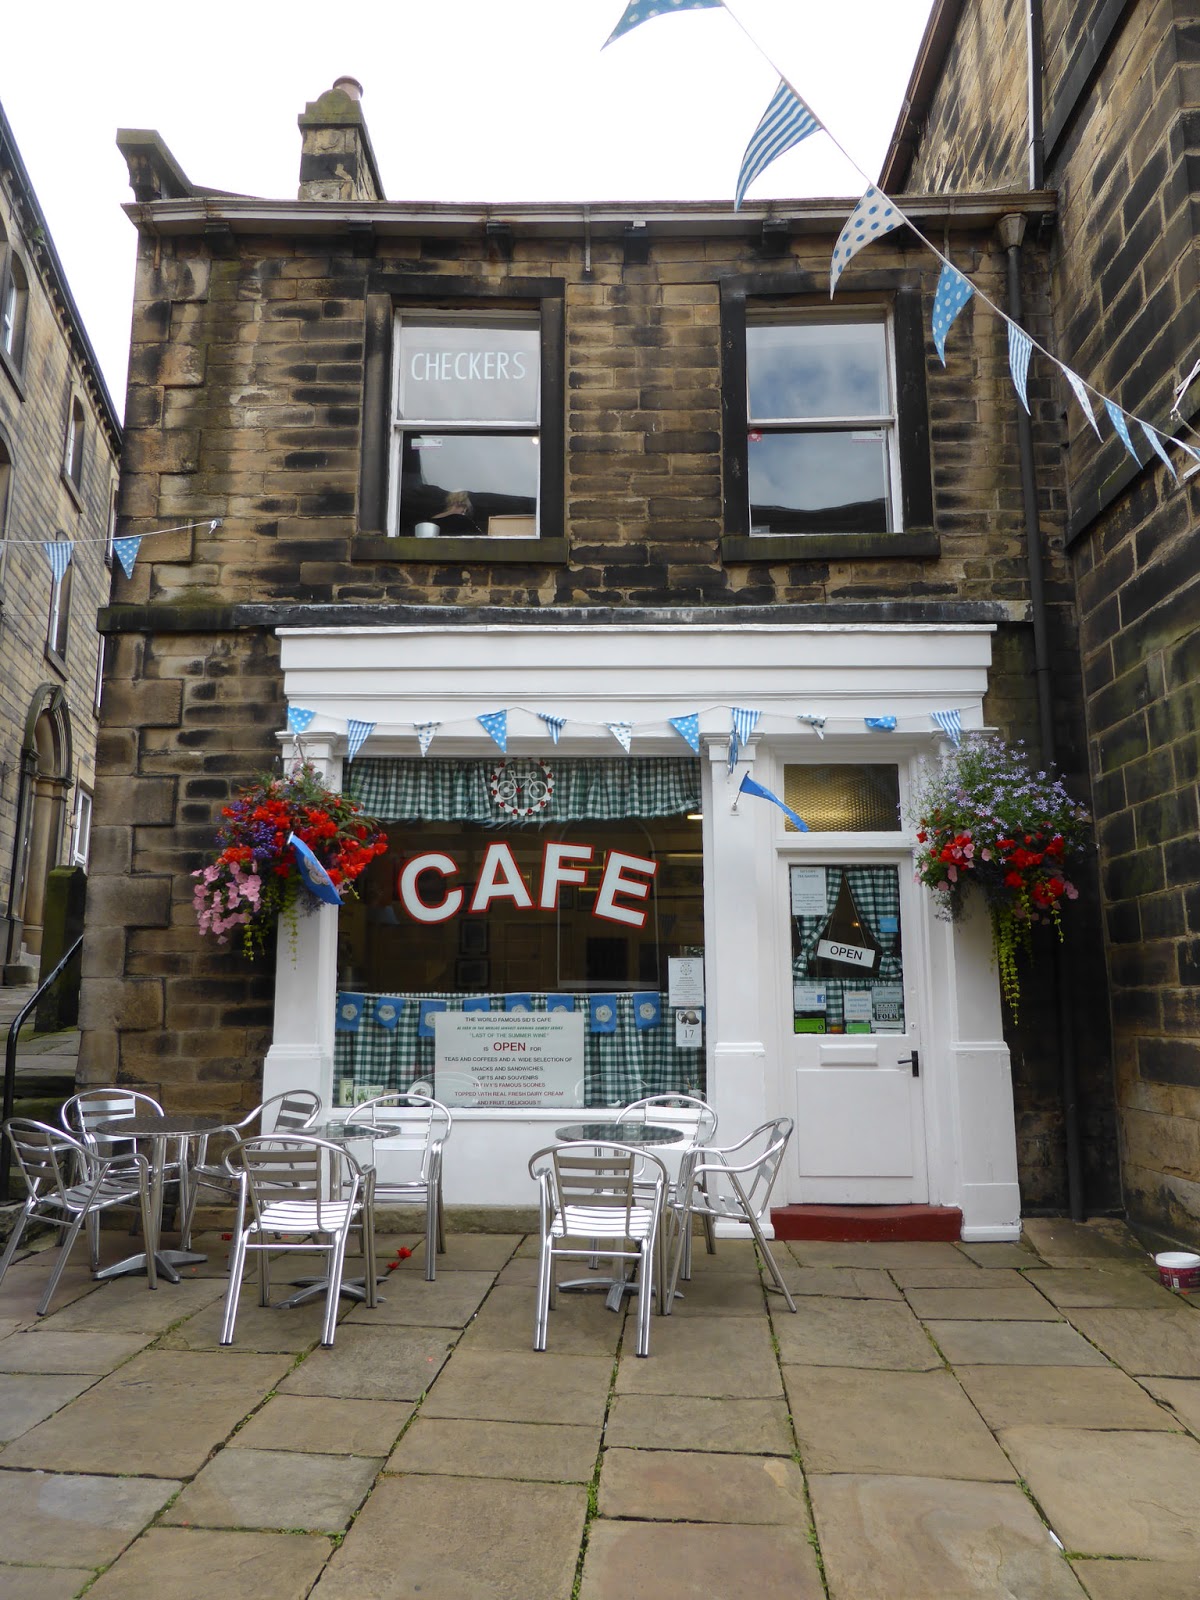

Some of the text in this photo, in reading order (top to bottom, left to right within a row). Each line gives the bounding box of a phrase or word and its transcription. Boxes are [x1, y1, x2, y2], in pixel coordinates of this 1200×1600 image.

[411, 351, 526, 380] CHECKERS
[398, 840, 660, 929] CAFE
[830, 945, 863, 960] OPEN
[684, 1029, 694, 1038] 17
[493, 1042, 526, 1051] OPEN
